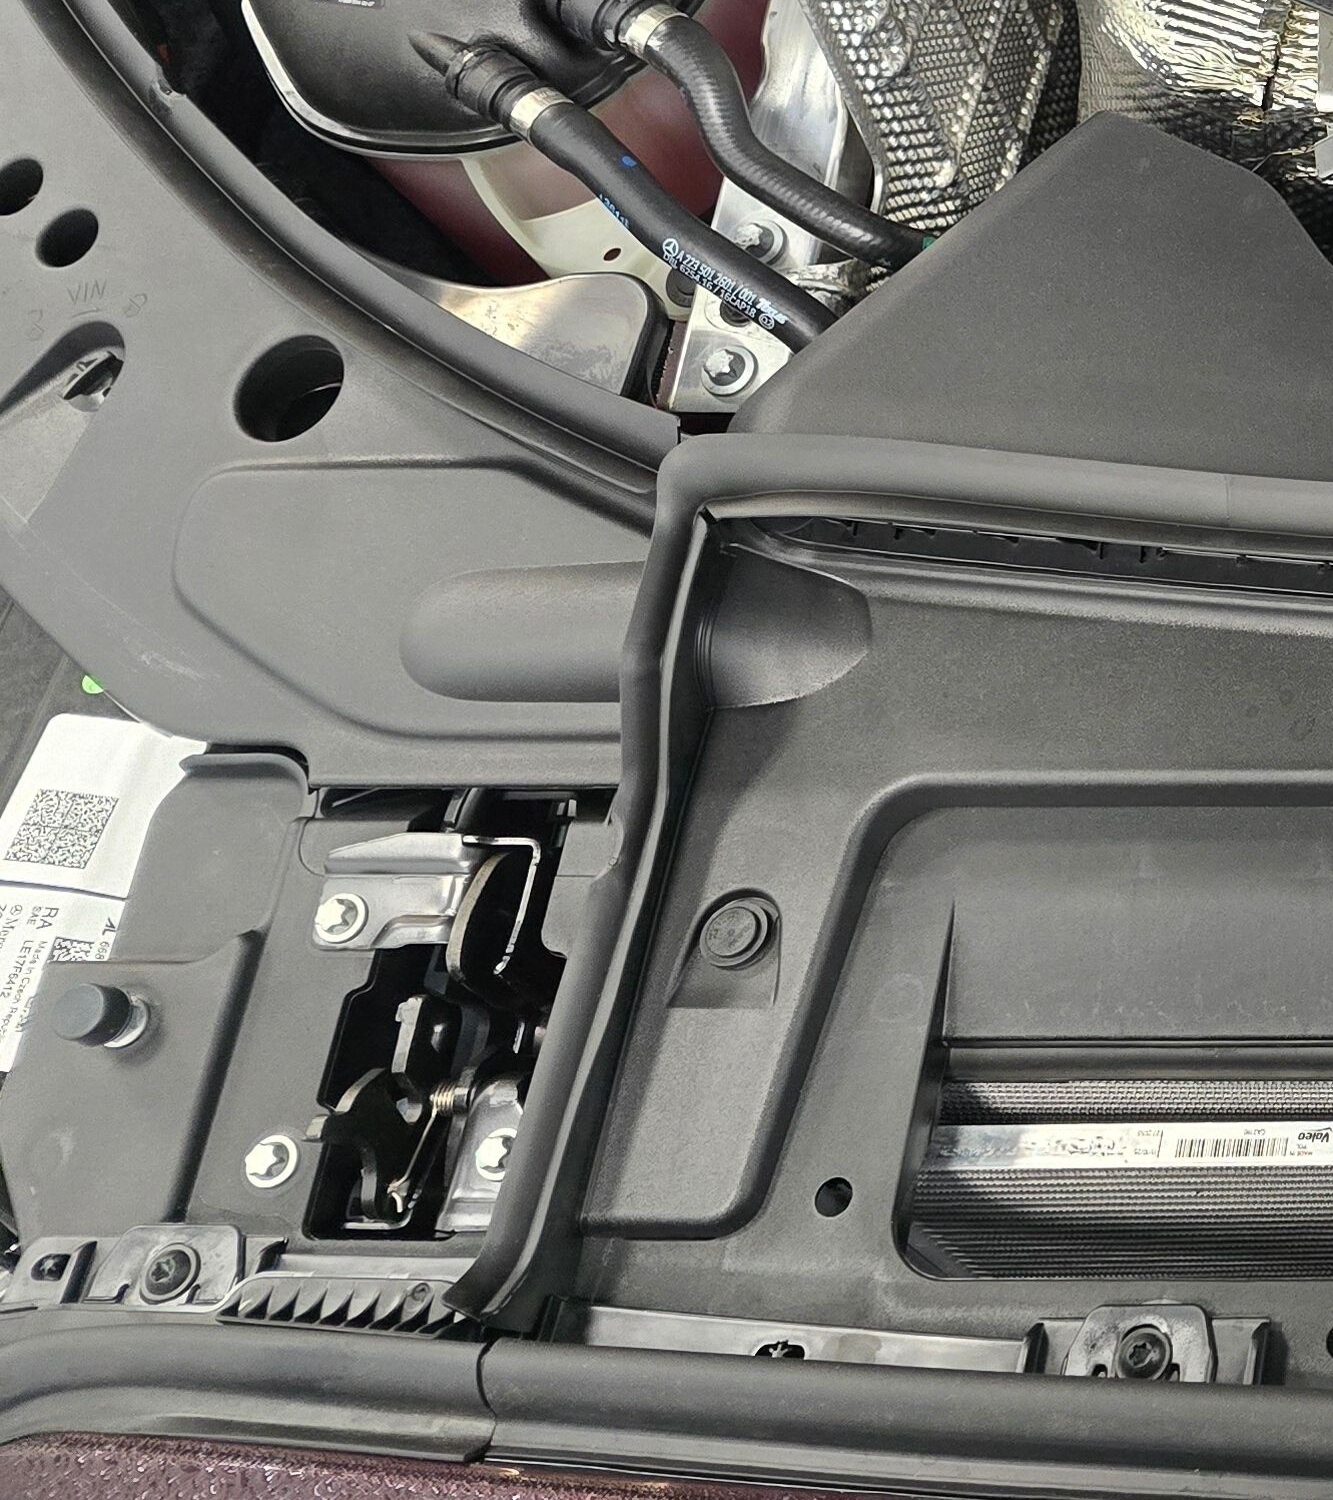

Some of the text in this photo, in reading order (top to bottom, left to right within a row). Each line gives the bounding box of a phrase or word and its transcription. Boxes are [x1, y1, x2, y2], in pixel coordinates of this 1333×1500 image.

[684, 253, 700, 270] 223
[699, 264, 715, 280] 501
[66, 278, 108, 305] VIN
[27, 906, 42, 926] SAE
[36, 907, 59, 930] RA
[30, 941, 48, 965] Made
[12, 977, 31, 1004] Czech
[1298, 1131, 1330, 1143] Valeo
